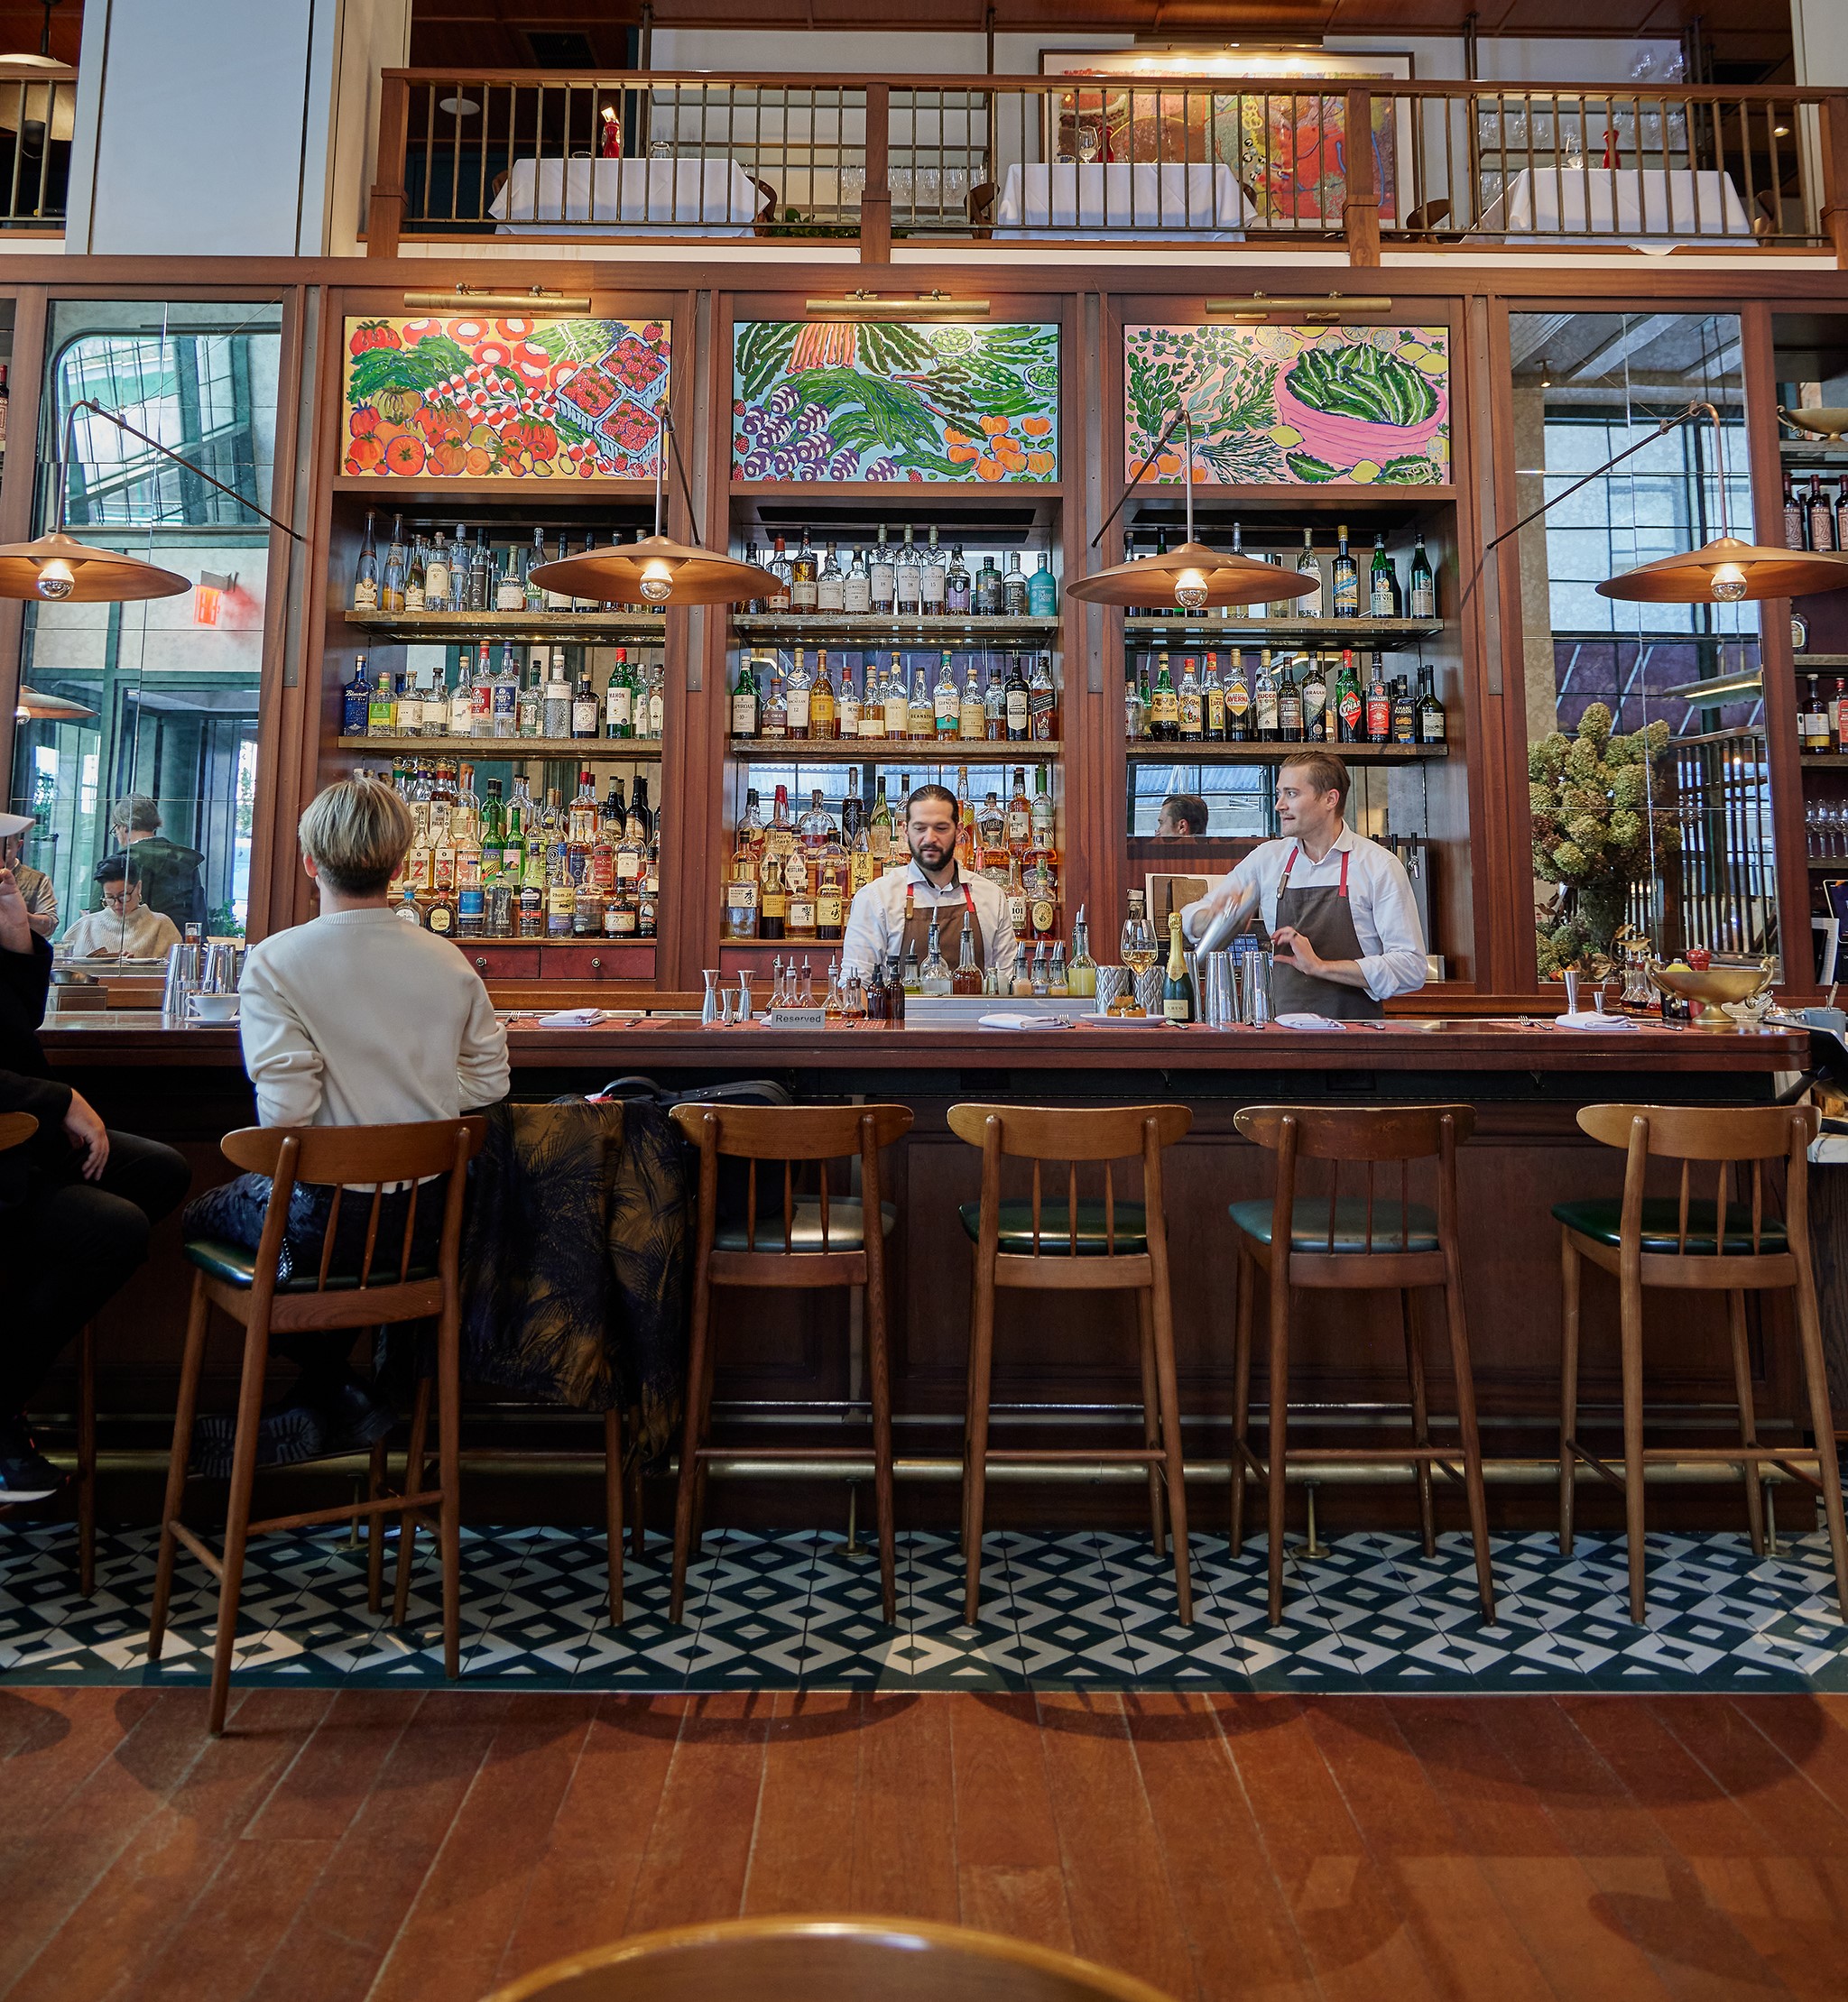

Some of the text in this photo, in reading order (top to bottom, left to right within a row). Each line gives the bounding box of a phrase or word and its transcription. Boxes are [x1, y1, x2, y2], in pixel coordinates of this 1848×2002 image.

[1339, 700, 1361, 717] CYNAR
[413, 861, 423, 877] 2
[438, 861, 449, 876] 3
[775, 1014, 821, 1023] Reserved
